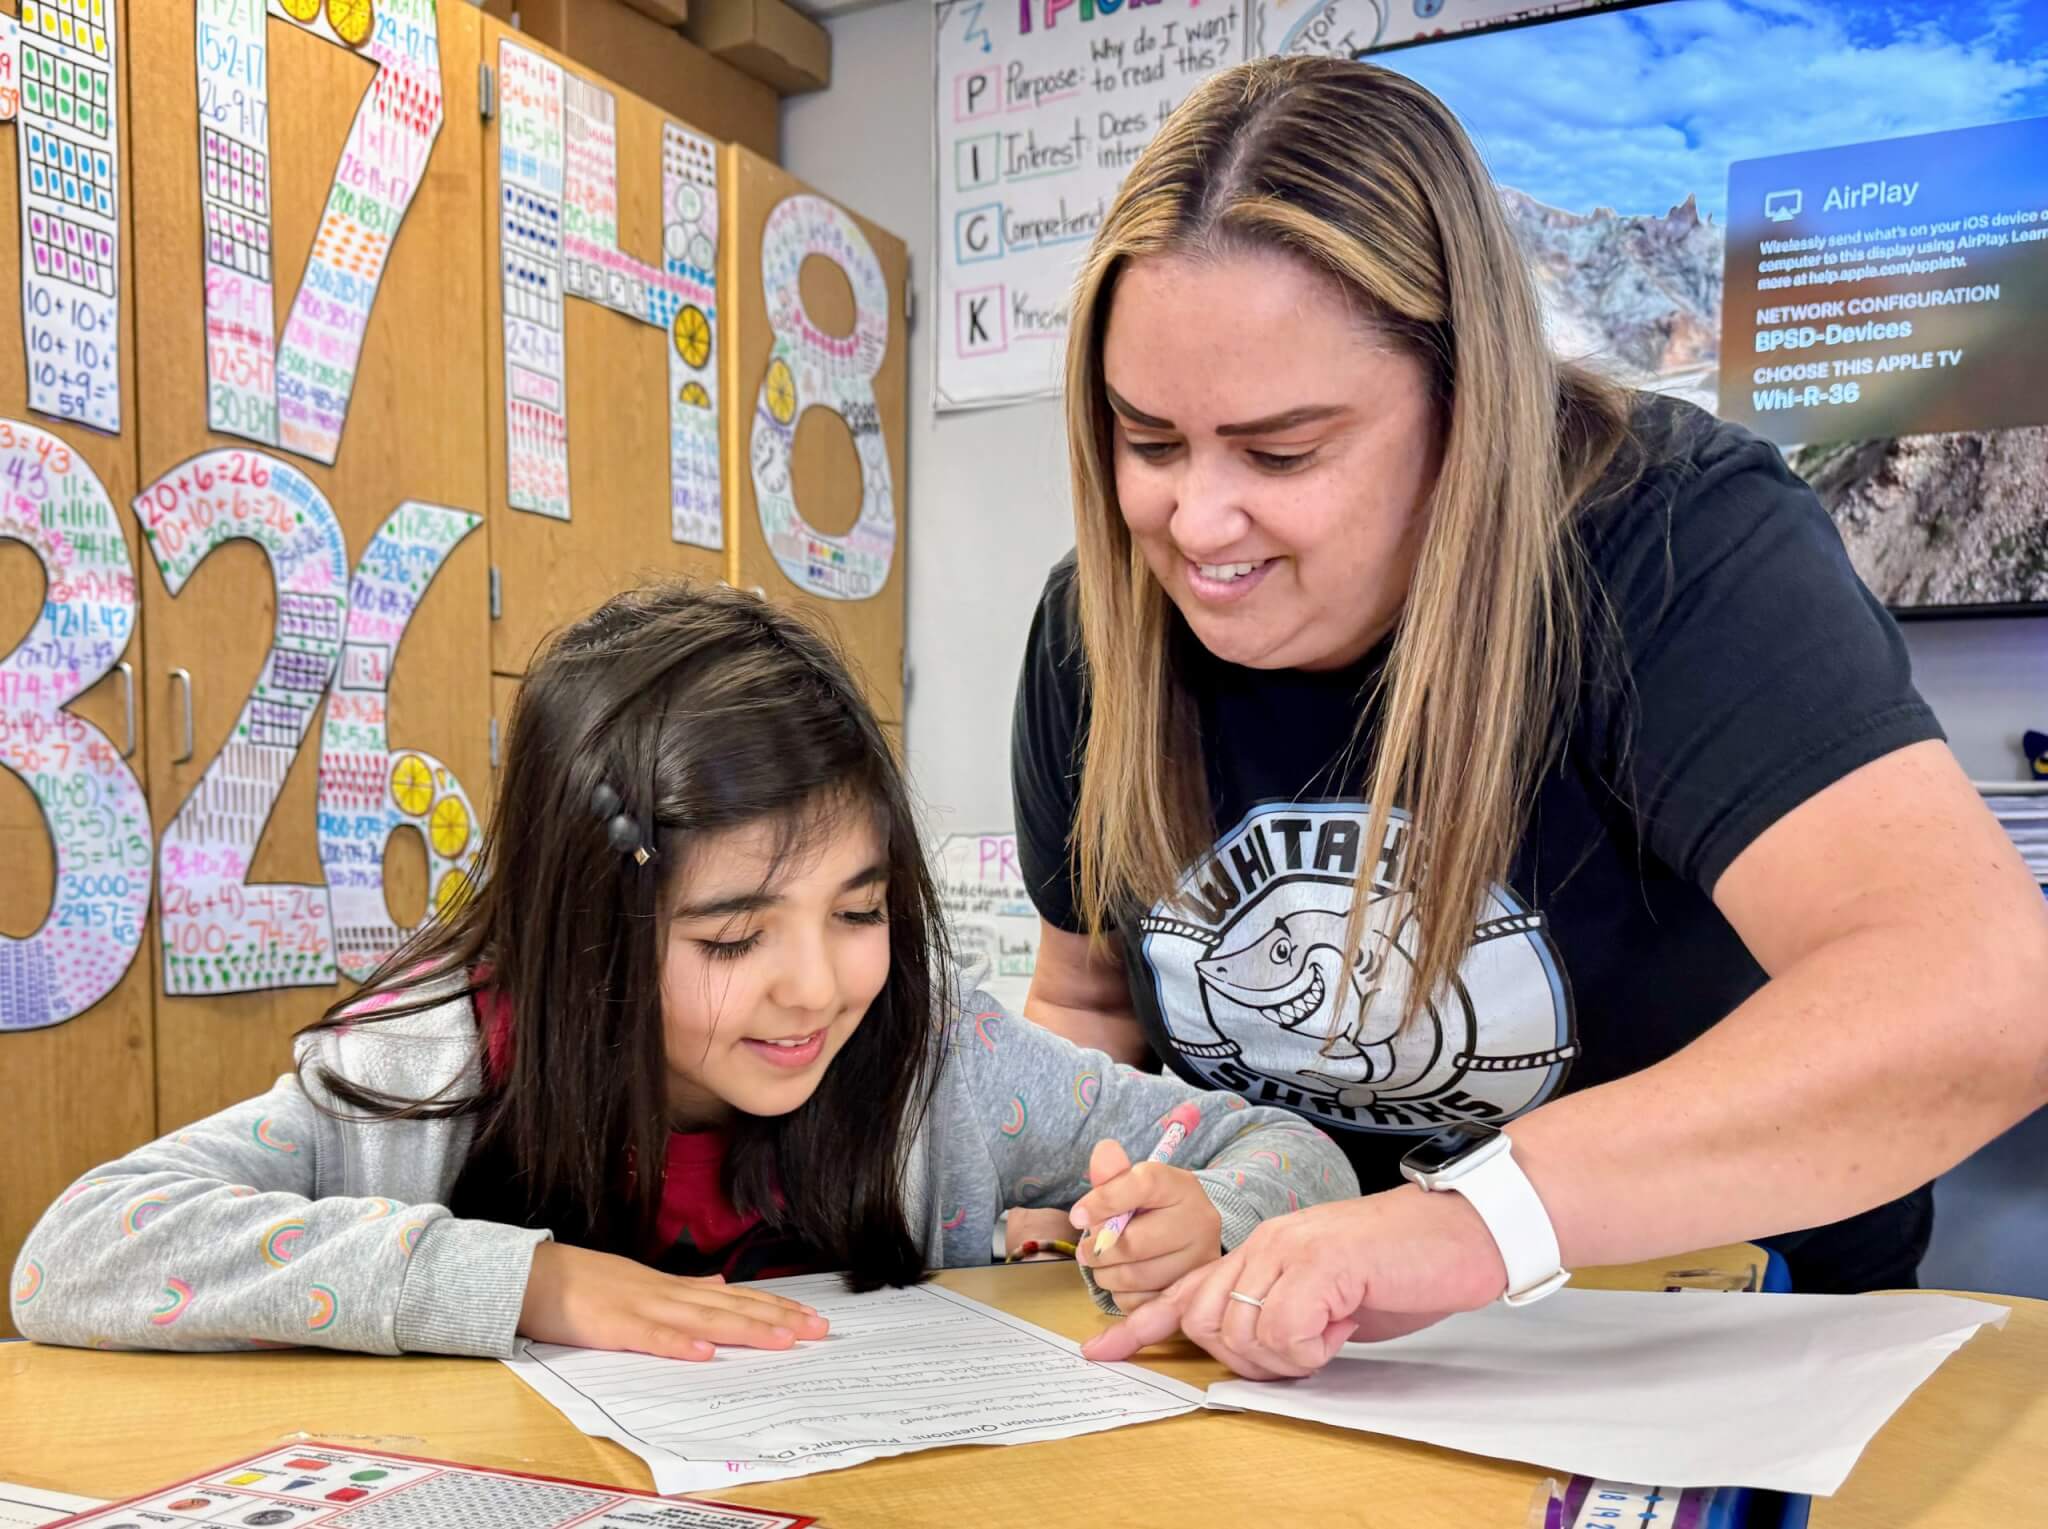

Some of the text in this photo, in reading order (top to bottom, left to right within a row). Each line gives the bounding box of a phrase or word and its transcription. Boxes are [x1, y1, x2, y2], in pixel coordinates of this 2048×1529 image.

[1091, 38, 1124, 68] Why
[1134, 25, 1156, 54] do
[1161, 22, 1178, 50] I
[1185, 4, 1238, 43] want
[967, 60, 1085, 112] P Purpose:
[1092, 70, 1116, 92] to
[1122, 55, 1165, 87] read
[1098, 111, 1147, 140] Does
[1822, 181, 1919, 213] AirPlay
[966, 214, 988, 252] C
[1760, 237, 1826, 255] Wirelessly
[1829, 231, 1861, 247] send
[1864, 224, 1908, 243] what's
[1910, 225, 1926, 237] on
[1930, 222, 1960, 238] your
[1963, 215, 1989, 230] iOS
[1992, 209, 2038, 227] device
[1758, 255, 1821, 273] computer
[1823, 252, 1838, 265] to
[1840, 247, 1865, 263] this
[1867, 241, 1915, 261] display
[1917, 238, 1954, 256] using
[2011, 228, 2047, 244] Learn
[1758, 275, 1792, 289] more
[1793, 272, 1808, 286] at
[970, 297, 989, 345] K
[1756, 284, 2000, 325] NETWORK CONFIGURATION
[1755, 319, 1913, 352] BPSD-Devices
[1753, 349, 1963, 385] CHOOSE THIS APPLE TV
[58, 393, 86, 416] 59
[1753, 382, 1860, 412] Whi-R-36
[1000, 1407, 1127, 1429] Comprehension
